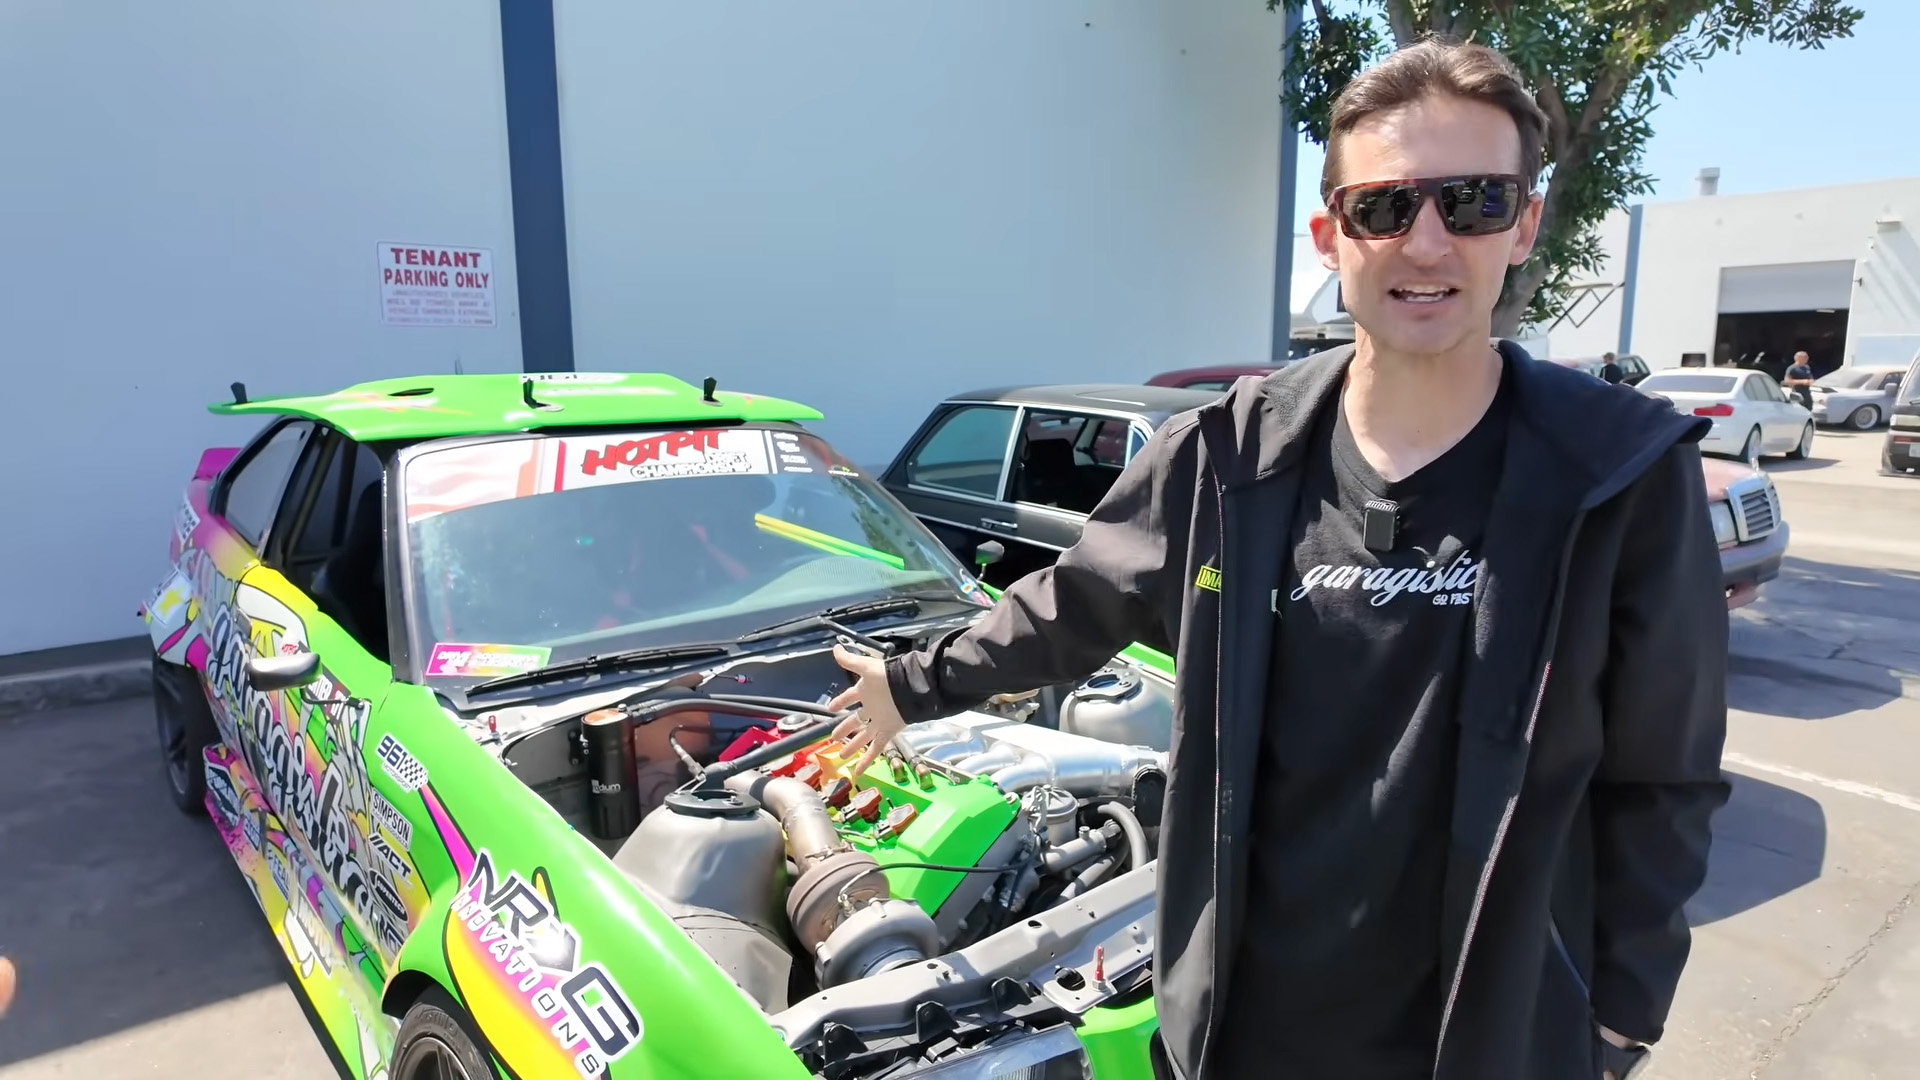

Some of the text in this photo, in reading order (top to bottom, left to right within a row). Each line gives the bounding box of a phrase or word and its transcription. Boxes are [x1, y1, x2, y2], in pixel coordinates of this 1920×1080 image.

[390, 248, 481, 268] TENANT
[384, 268, 489, 288] PARKING ONLY
[582, 430, 728, 475] HOTPIT
[1450, 592, 1473, 605] FAS
[377, 735, 407, 770] 961
[374, 793, 410, 842] SIMPSON
[377, 879, 406, 915] SUPERTECH
